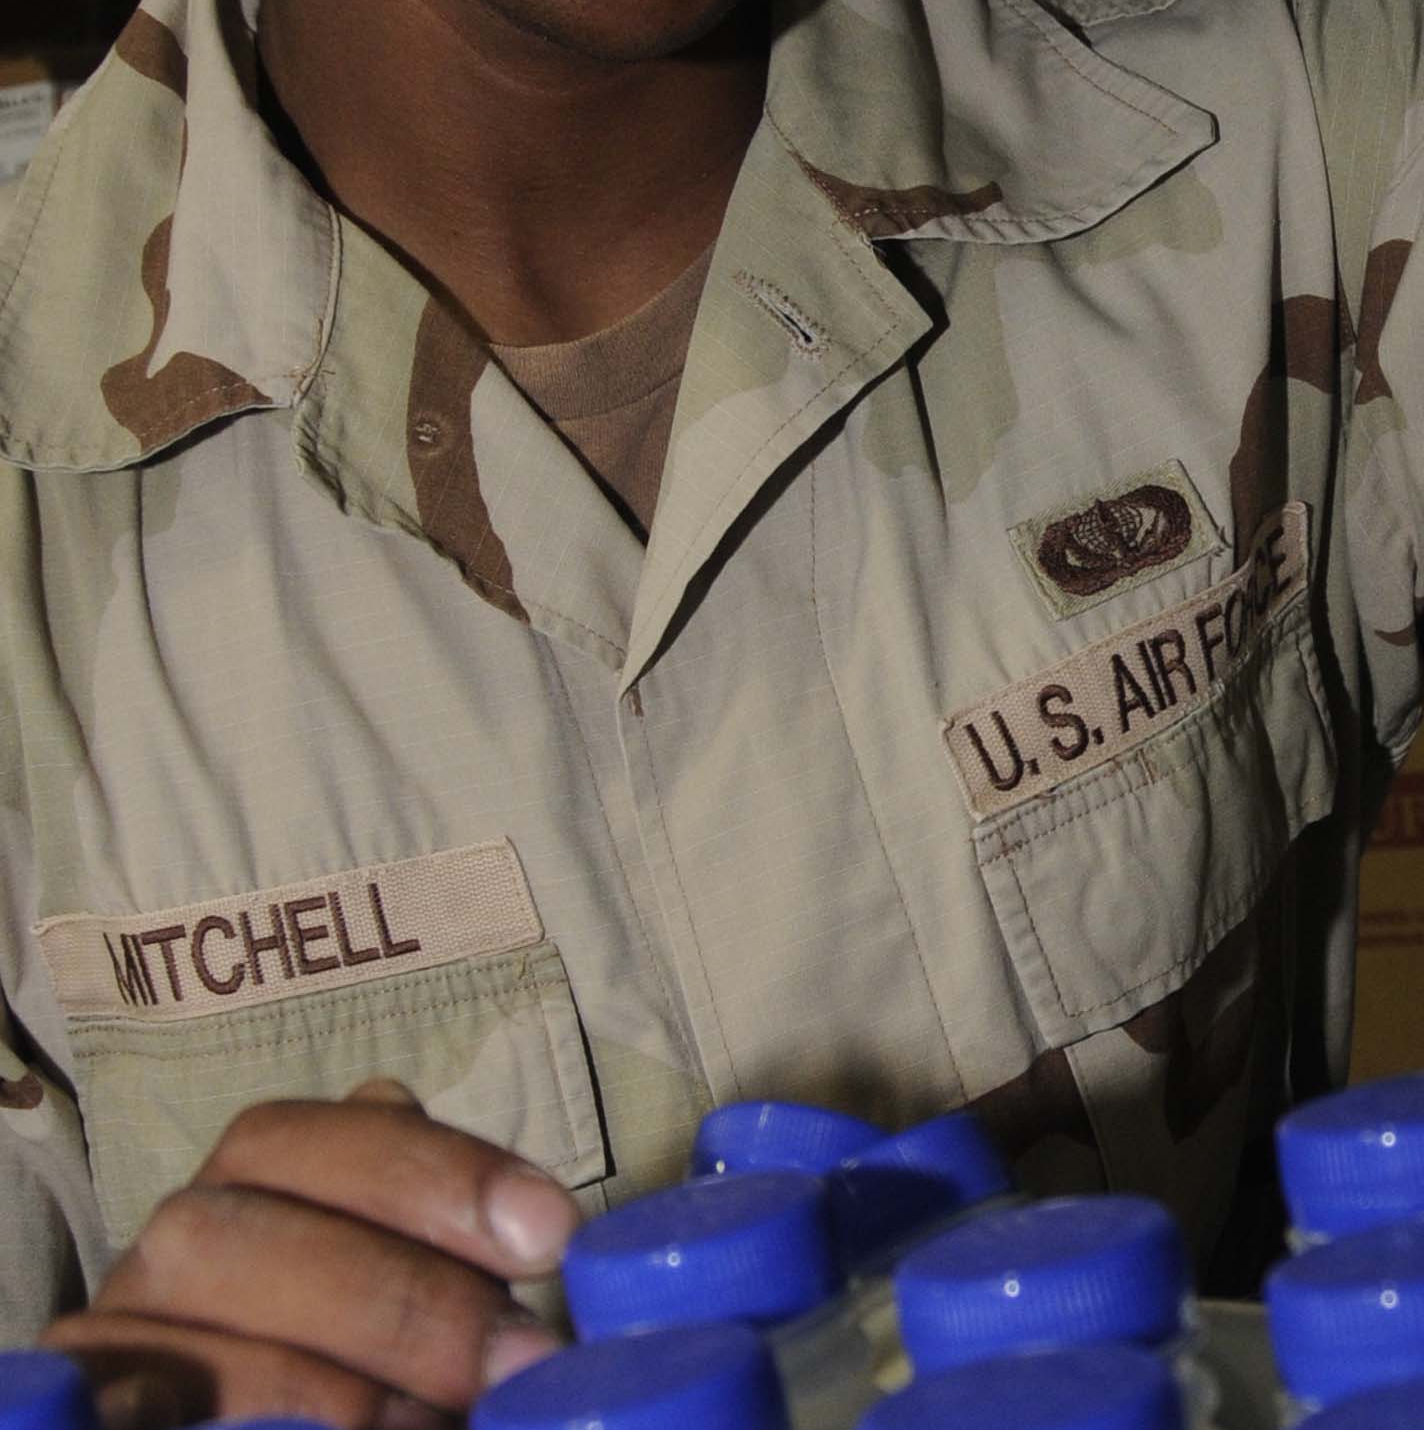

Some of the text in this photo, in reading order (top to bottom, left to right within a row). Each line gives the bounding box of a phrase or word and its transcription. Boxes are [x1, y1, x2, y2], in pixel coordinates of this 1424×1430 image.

[964, 525, 1292, 792] U.S. AIR FOCE
[103, 882, 421, 1006] MITCHELL
